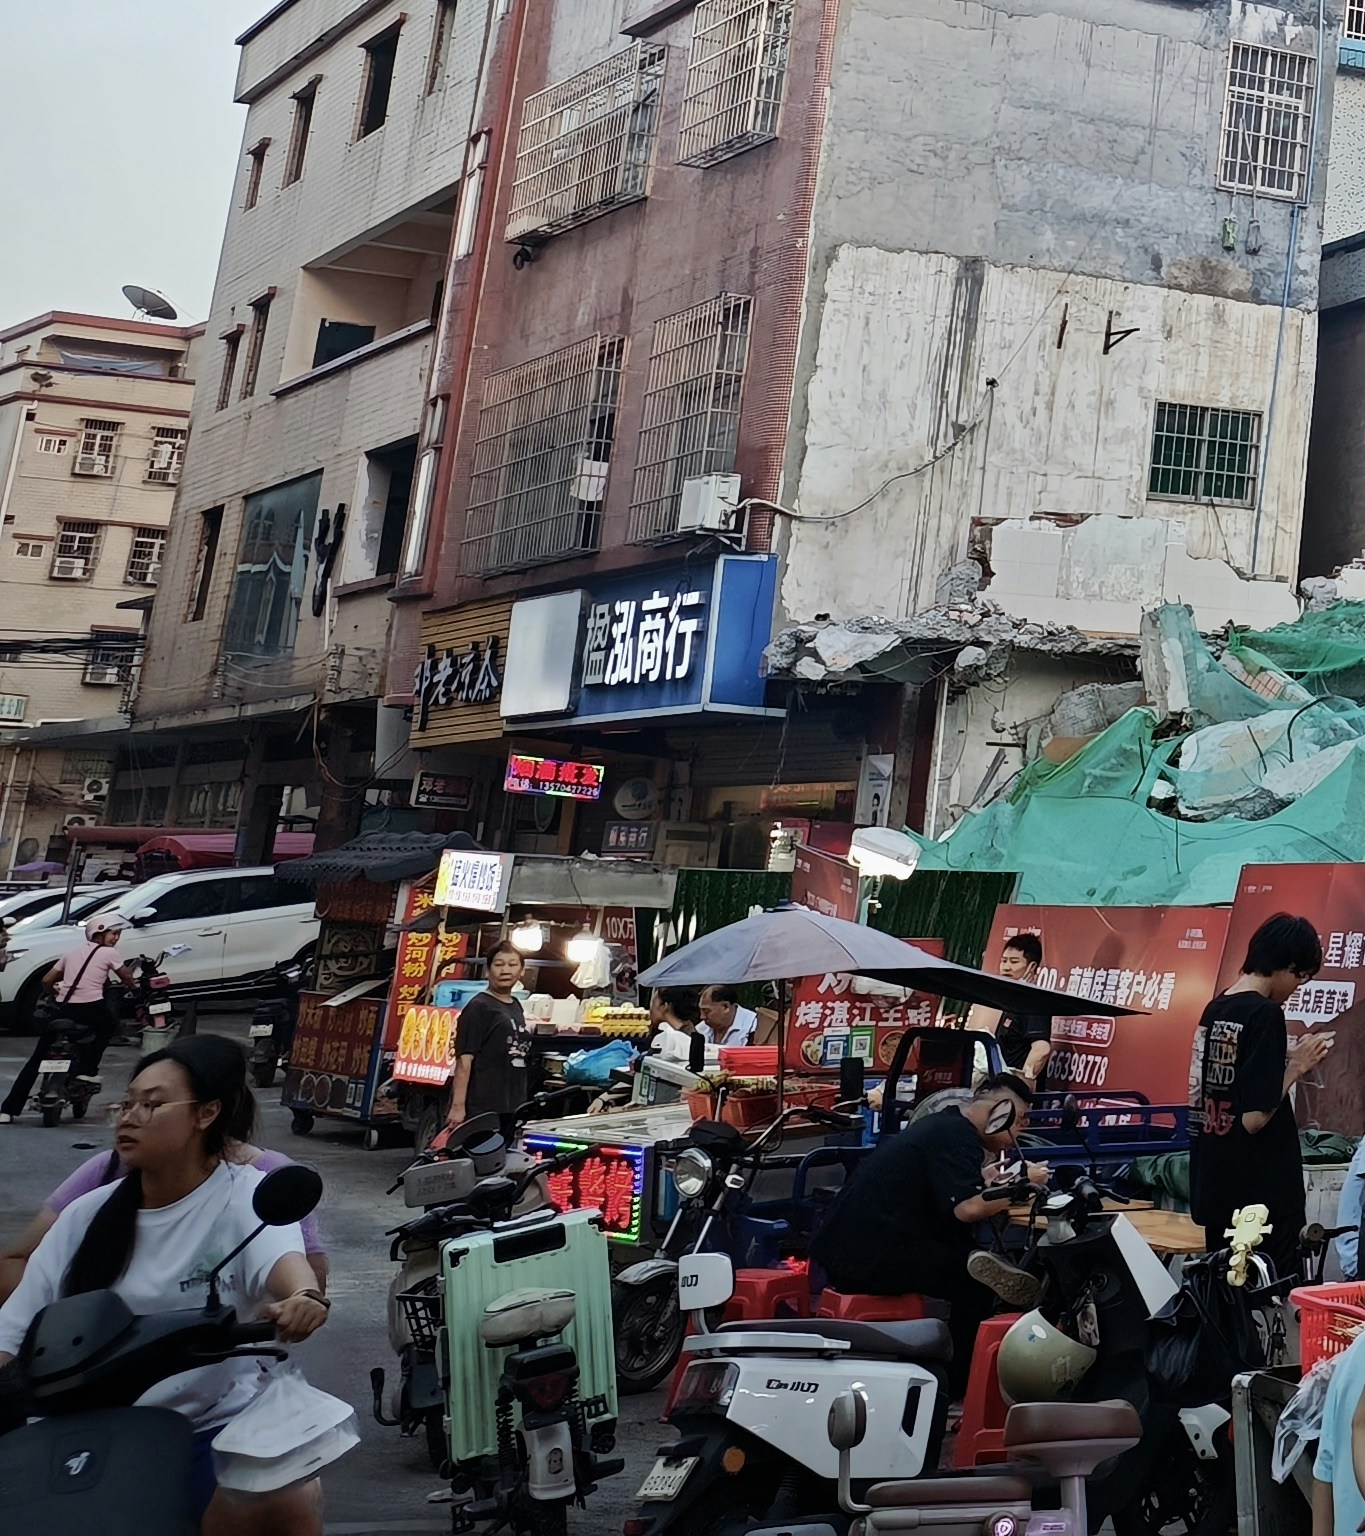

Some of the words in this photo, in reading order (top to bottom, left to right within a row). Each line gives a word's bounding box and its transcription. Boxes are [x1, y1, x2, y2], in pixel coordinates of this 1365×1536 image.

[1281, 987, 1350, 1016] 票兑房首选
